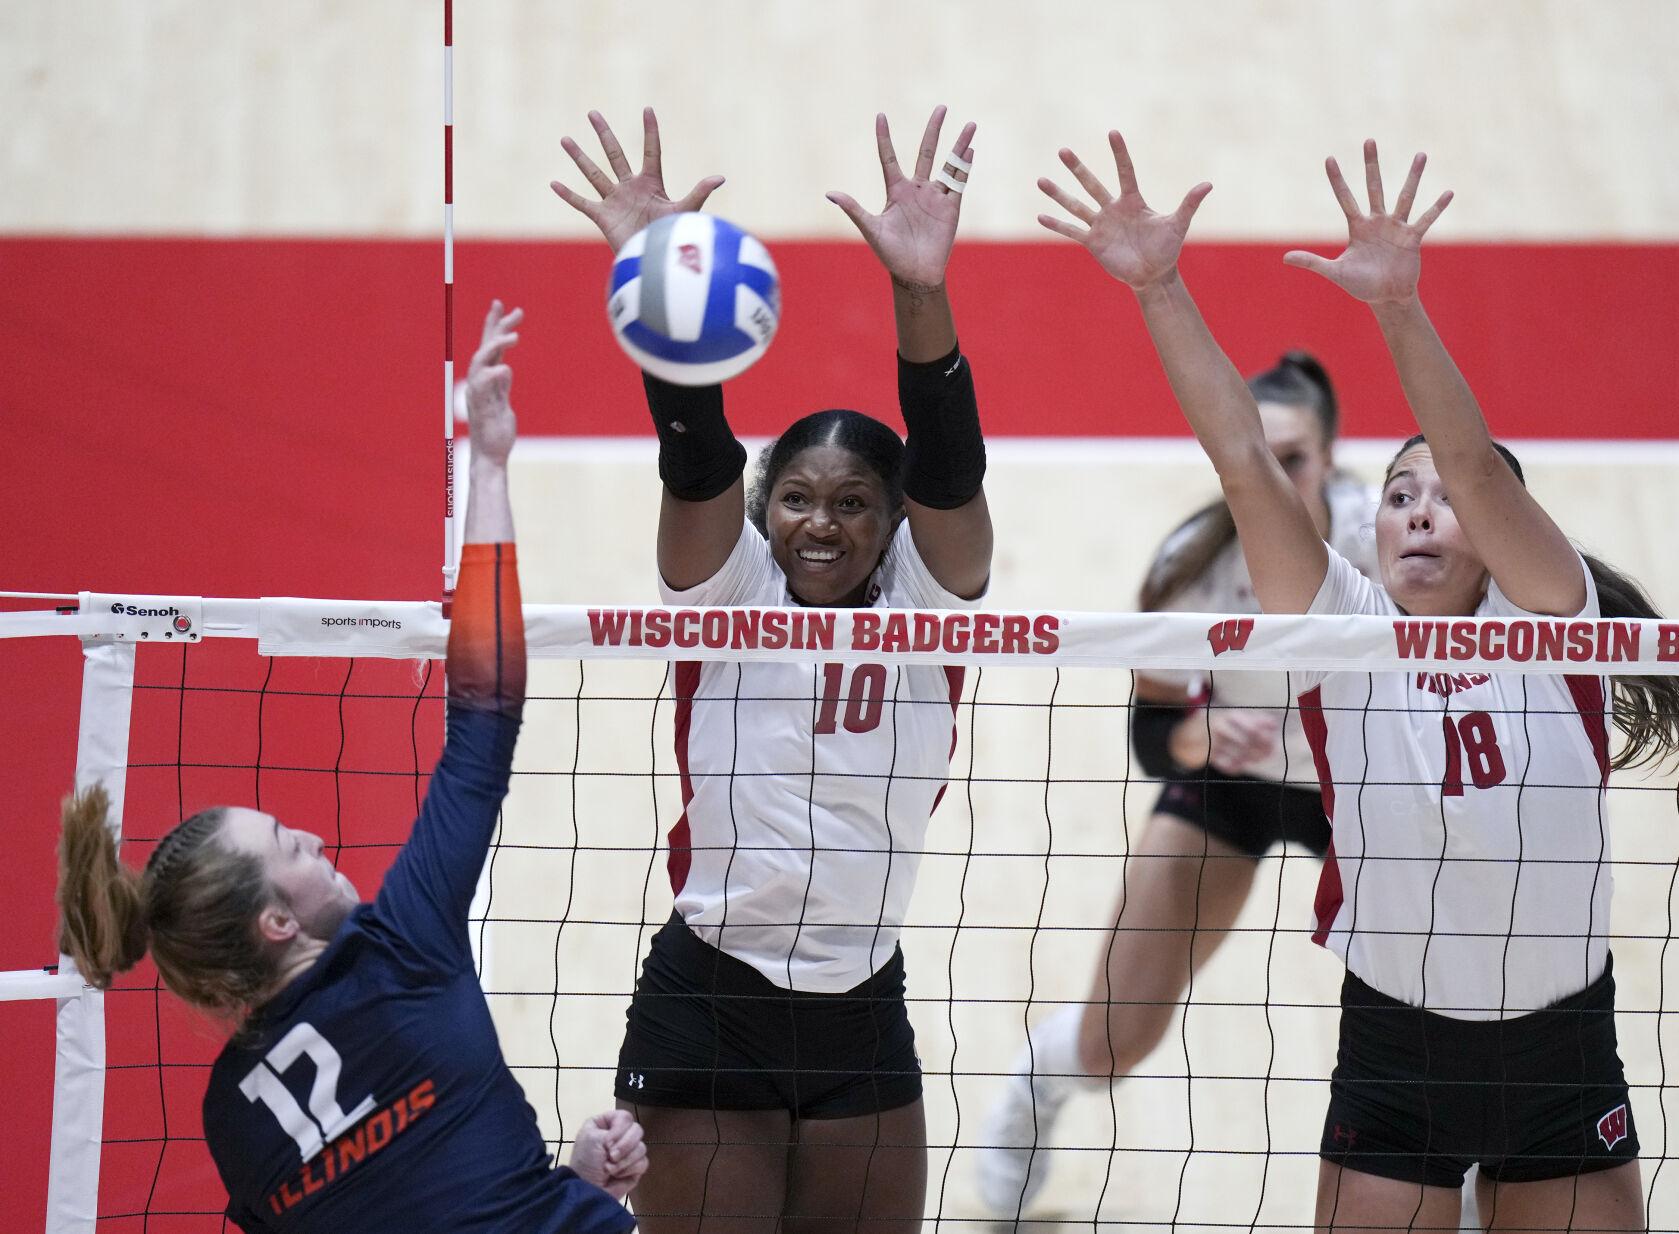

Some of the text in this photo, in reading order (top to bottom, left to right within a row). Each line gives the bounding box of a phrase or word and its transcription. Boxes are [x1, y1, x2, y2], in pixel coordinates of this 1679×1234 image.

[126, 605, 179, 617] Senoh
[321, 617, 402, 630] sports imports
[587, 608, 1060, 655] WISCONSIN BADGERS
[1393, 620, 1641, 662] WISCONSIN
[814, 662, 887, 734] 10
[1443, 711, 1507, 797] 18
[238, 1021, 379, 1164] 12
[269, 1078, 437, 1216] ILLINOIS
